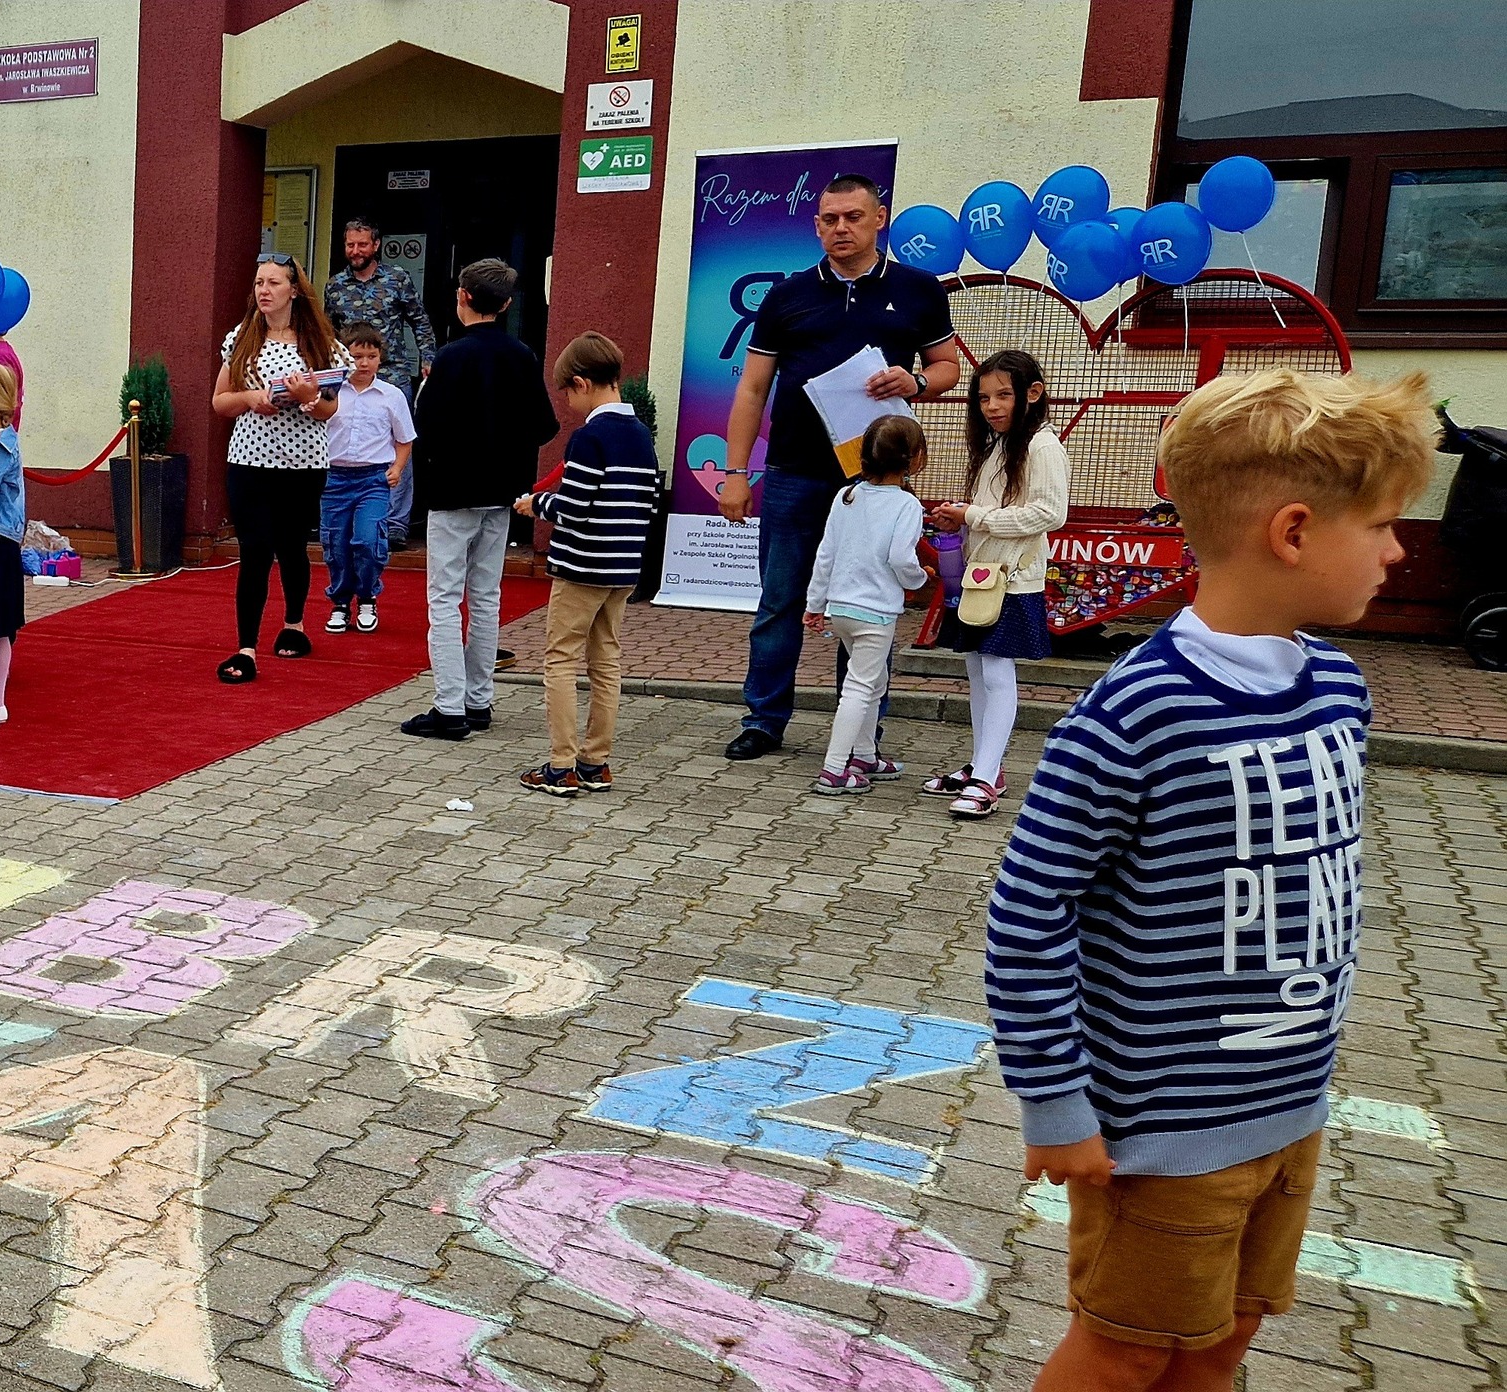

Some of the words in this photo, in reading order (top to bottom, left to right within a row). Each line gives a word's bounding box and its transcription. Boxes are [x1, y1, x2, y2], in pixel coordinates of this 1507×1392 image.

[611, 18, 638, 28] UWAGA!
[23, 48, 77, 64] PODSTAWOWA
[78, 47, 87, 59] Nr
[89, 46, 95, 58] 2
[5, 68, 40, 81] JAROSŁAWA
[42, 65, 90, 78] IWASZKIEWICZA
[30, 83, 61, 94] Brwinowie
[610, 153, 646, 169] AED
[700, 173, 782, 226] Razem
[785, 171, 817, 215] dla
[706, 520, 727, 528] Rada
[729, 520, 760, 529] Rodzic
[736, 542, 758, 550] Iwaszk
[680, 550, 706, 559] Zespole
[720, 562, 756, 570] Brwinowie
[683, 577, 762, 588] radarodzicow@zsobrwi
[1207, 723, 1364, 860] TEAM
[1223, 838, 1362, 975] PLAYE
